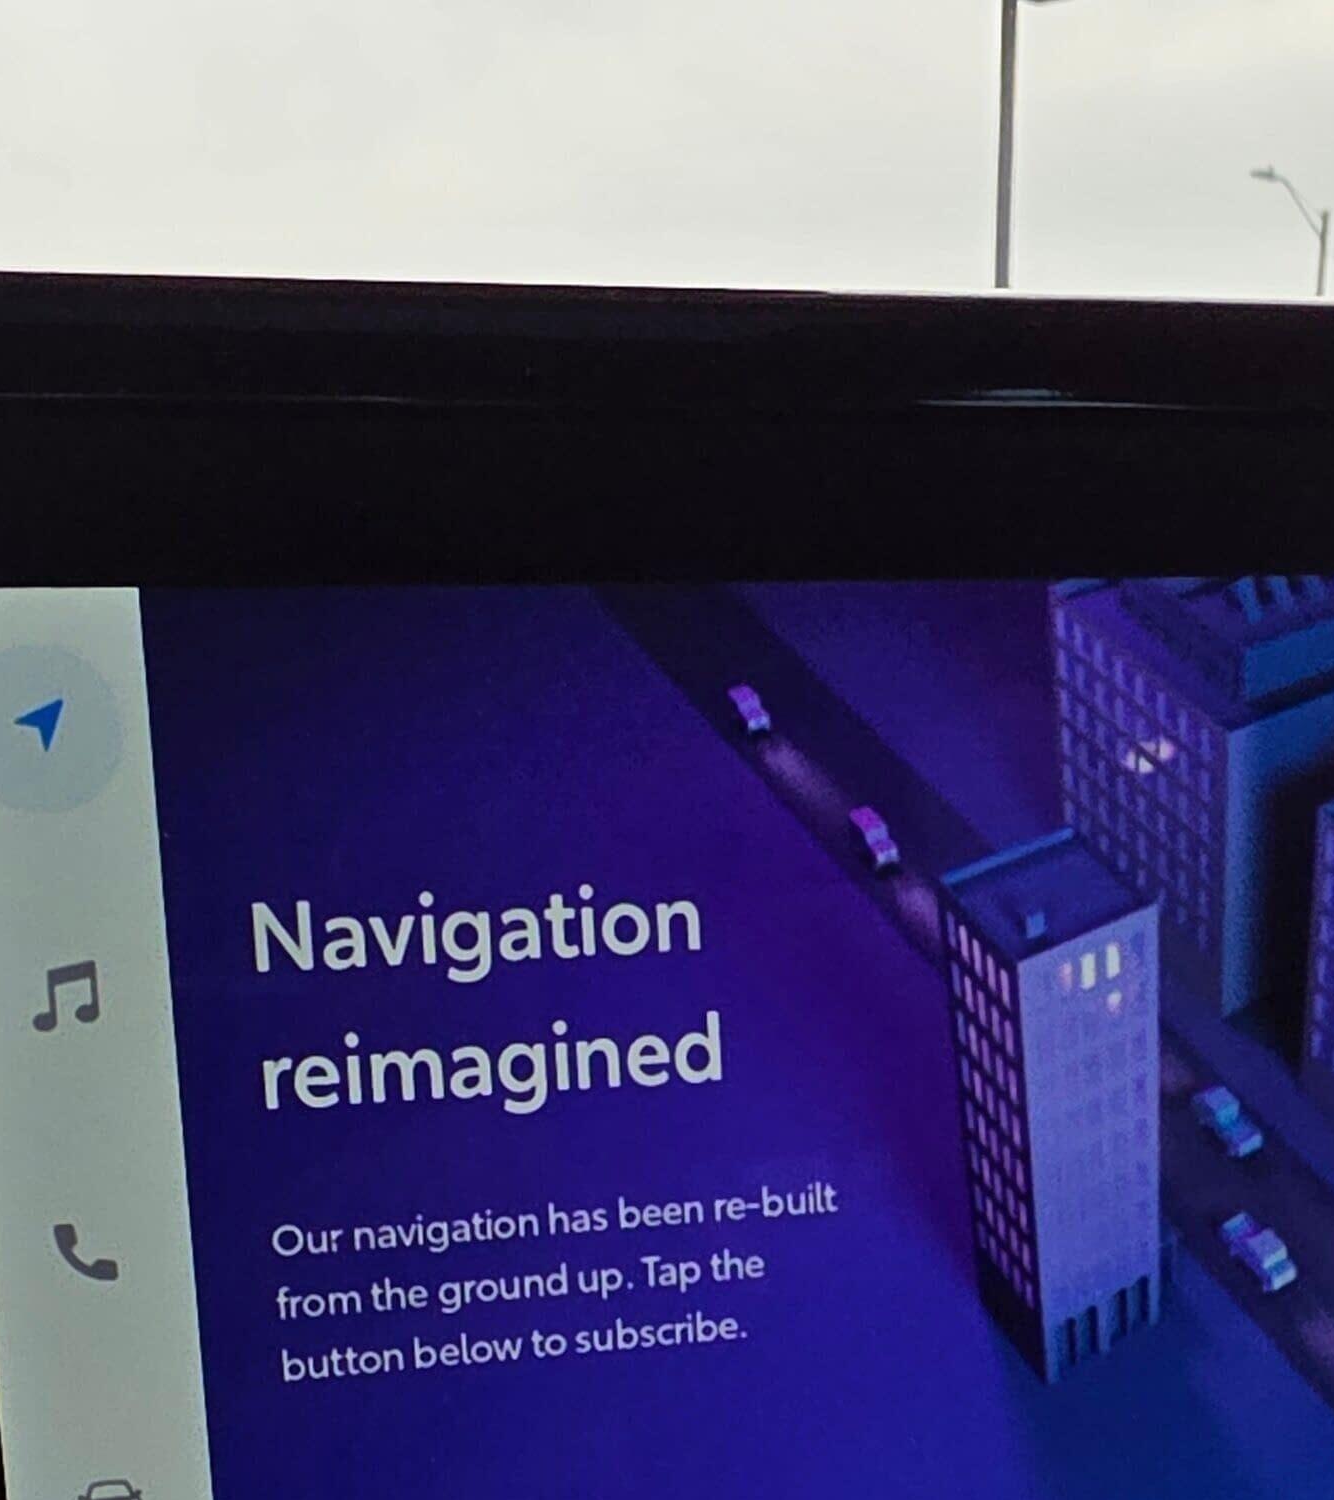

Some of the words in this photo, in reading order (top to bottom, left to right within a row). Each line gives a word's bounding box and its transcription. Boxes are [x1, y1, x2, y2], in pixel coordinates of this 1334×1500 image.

[250, 883, 703, 983] Navigation
[261, 1010, 723, 1114] reimagined
[272, 1224, 343, 1257] Our
[353, 1209, 539, 1253] navigation
[548, 1202, 609, 1235] has
[618, 1196, 704, 1230] been
[714, 1181, 839, 1222] re-built
[276, 1286, 362, 1320] from
[370, 1277, 429, 1312] the
[438, 1262, 568, 1314] ground
[577, 1267, 635, 1301] up.
[640, 1255, 701, 1294] Tap
[710, 1248, 765, 1282] the
[281, 1346, 405, 1383] button
[413, 1332, 523, 1369] below
[532, 1329, 567, 1358] to
[575, 1310, 748, 1353] subscribe.
